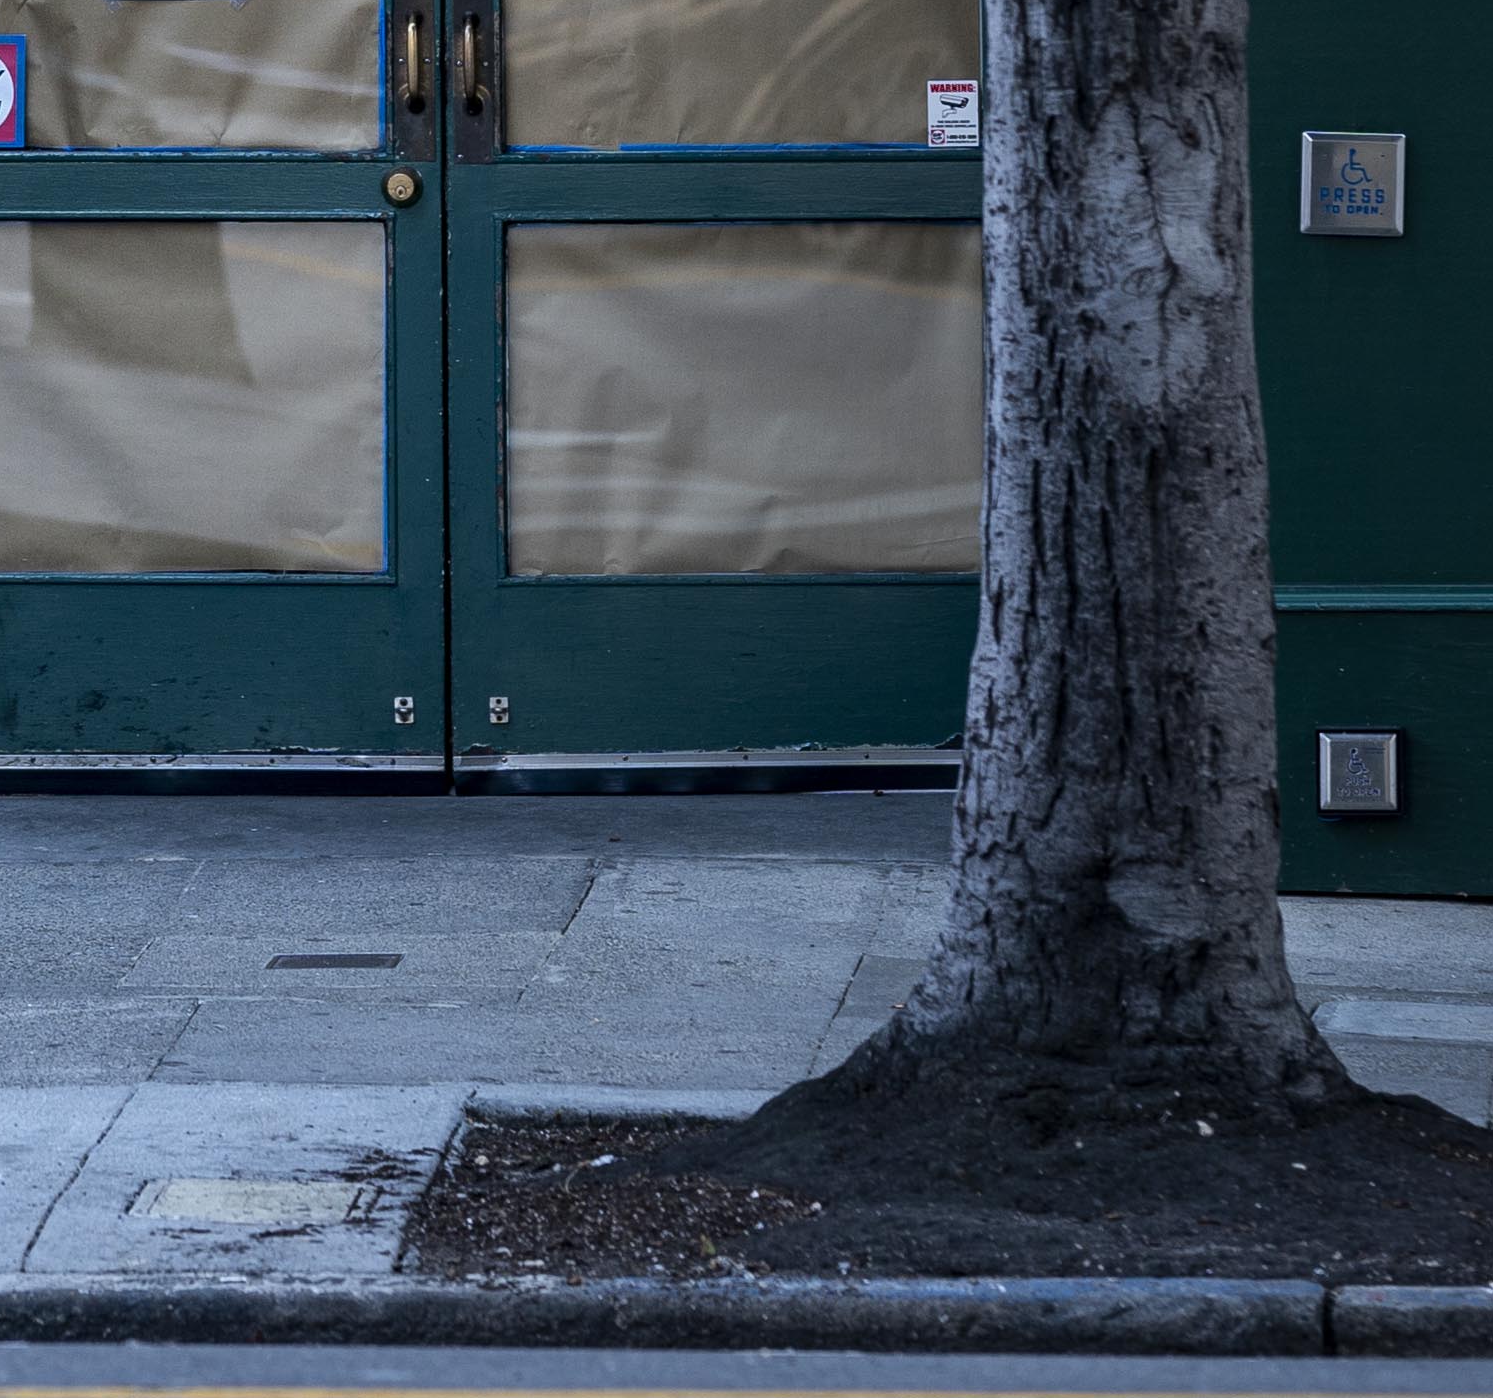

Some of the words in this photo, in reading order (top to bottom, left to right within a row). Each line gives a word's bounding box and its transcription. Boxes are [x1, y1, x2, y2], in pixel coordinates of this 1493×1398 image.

[930, 84, 976, 93] WARNING:
[1320, 186, 1384, 204] PRESS
[1326, 205, 1340, 214] TO
[1347, 205, 1378, 214] OPEN
